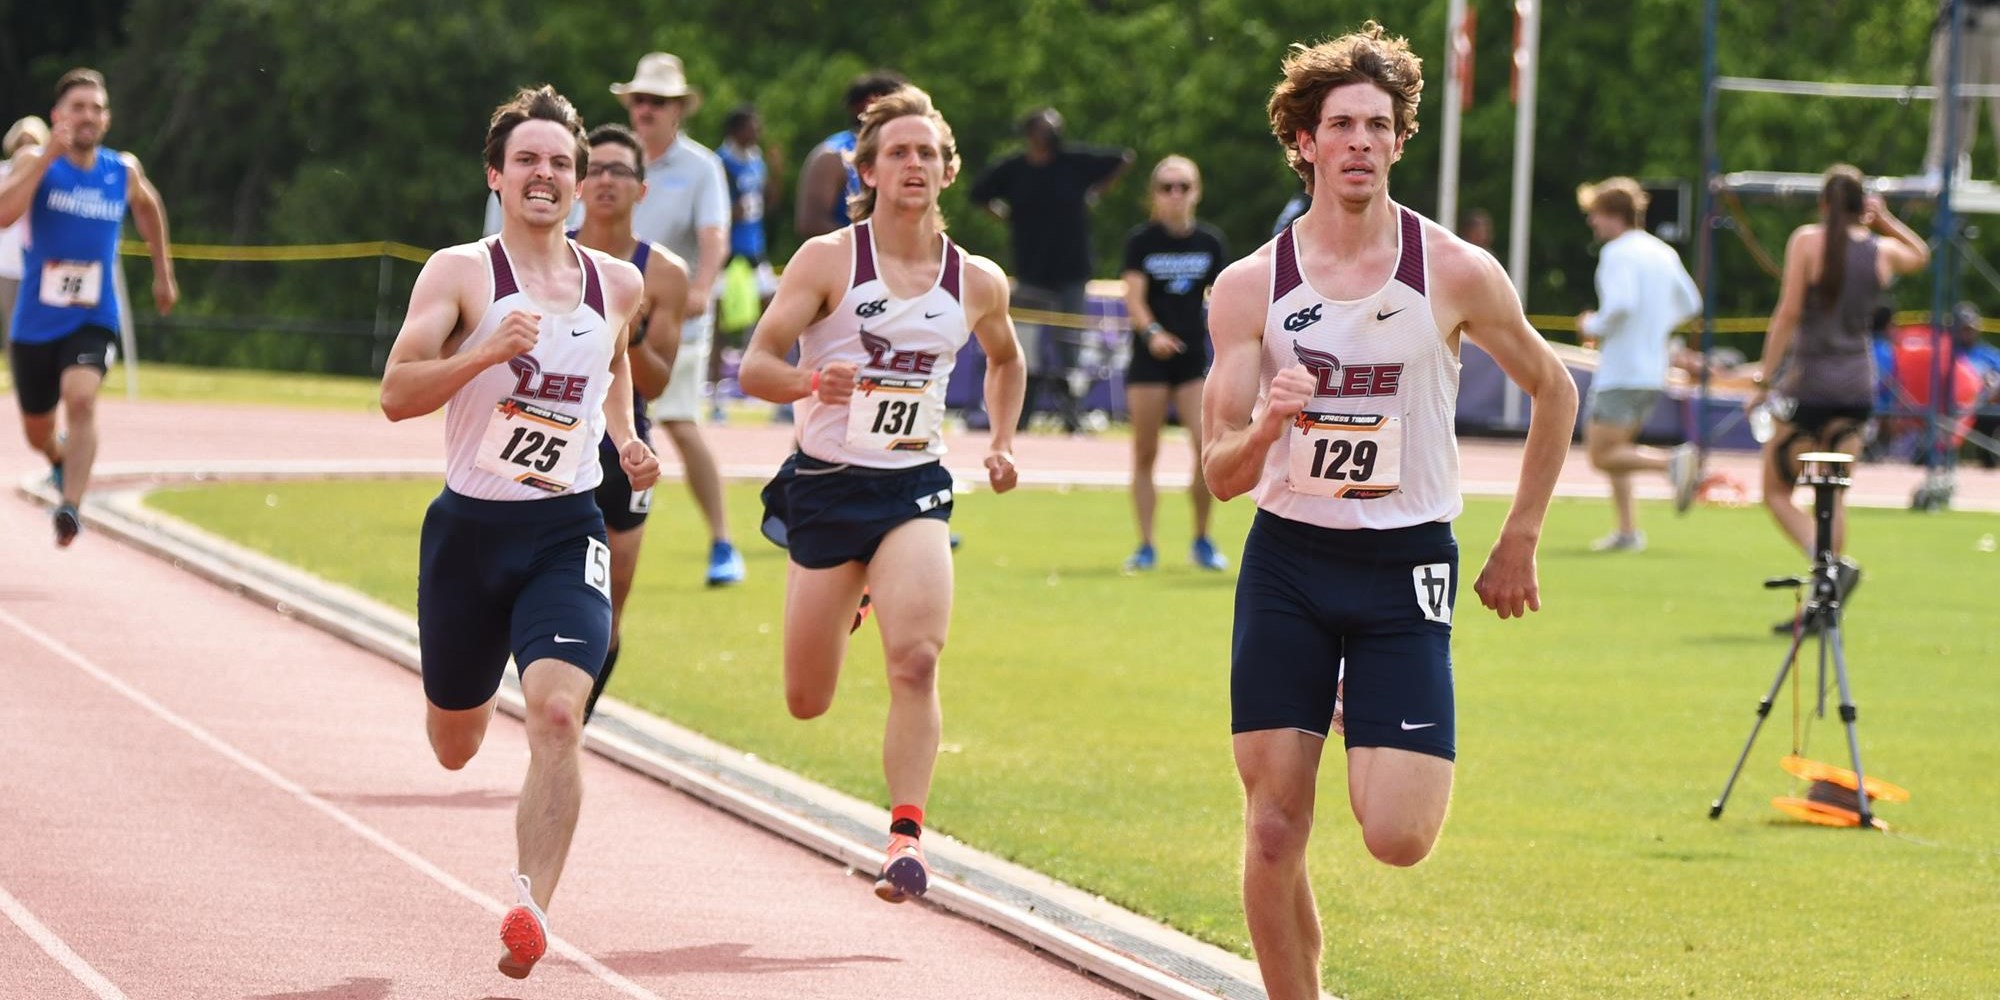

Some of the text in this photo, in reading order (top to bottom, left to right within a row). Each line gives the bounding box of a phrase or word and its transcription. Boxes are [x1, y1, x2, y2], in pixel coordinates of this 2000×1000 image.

[856, 299, 888, 318] GSC
[1283, 303, 1323, 332] GSC
[864, 349, 940, 376] LEE
[1313, 363, 1404, 398] LEE
[511, 367, 589, 405] LEE
[871, 400, 920, 436] 131
[499, 427, 568, 473] 125
[1310, 438, 1378, 482] 129
[593, 545, 606, 588] 5
[1421, 567, 1446, 617] 4
